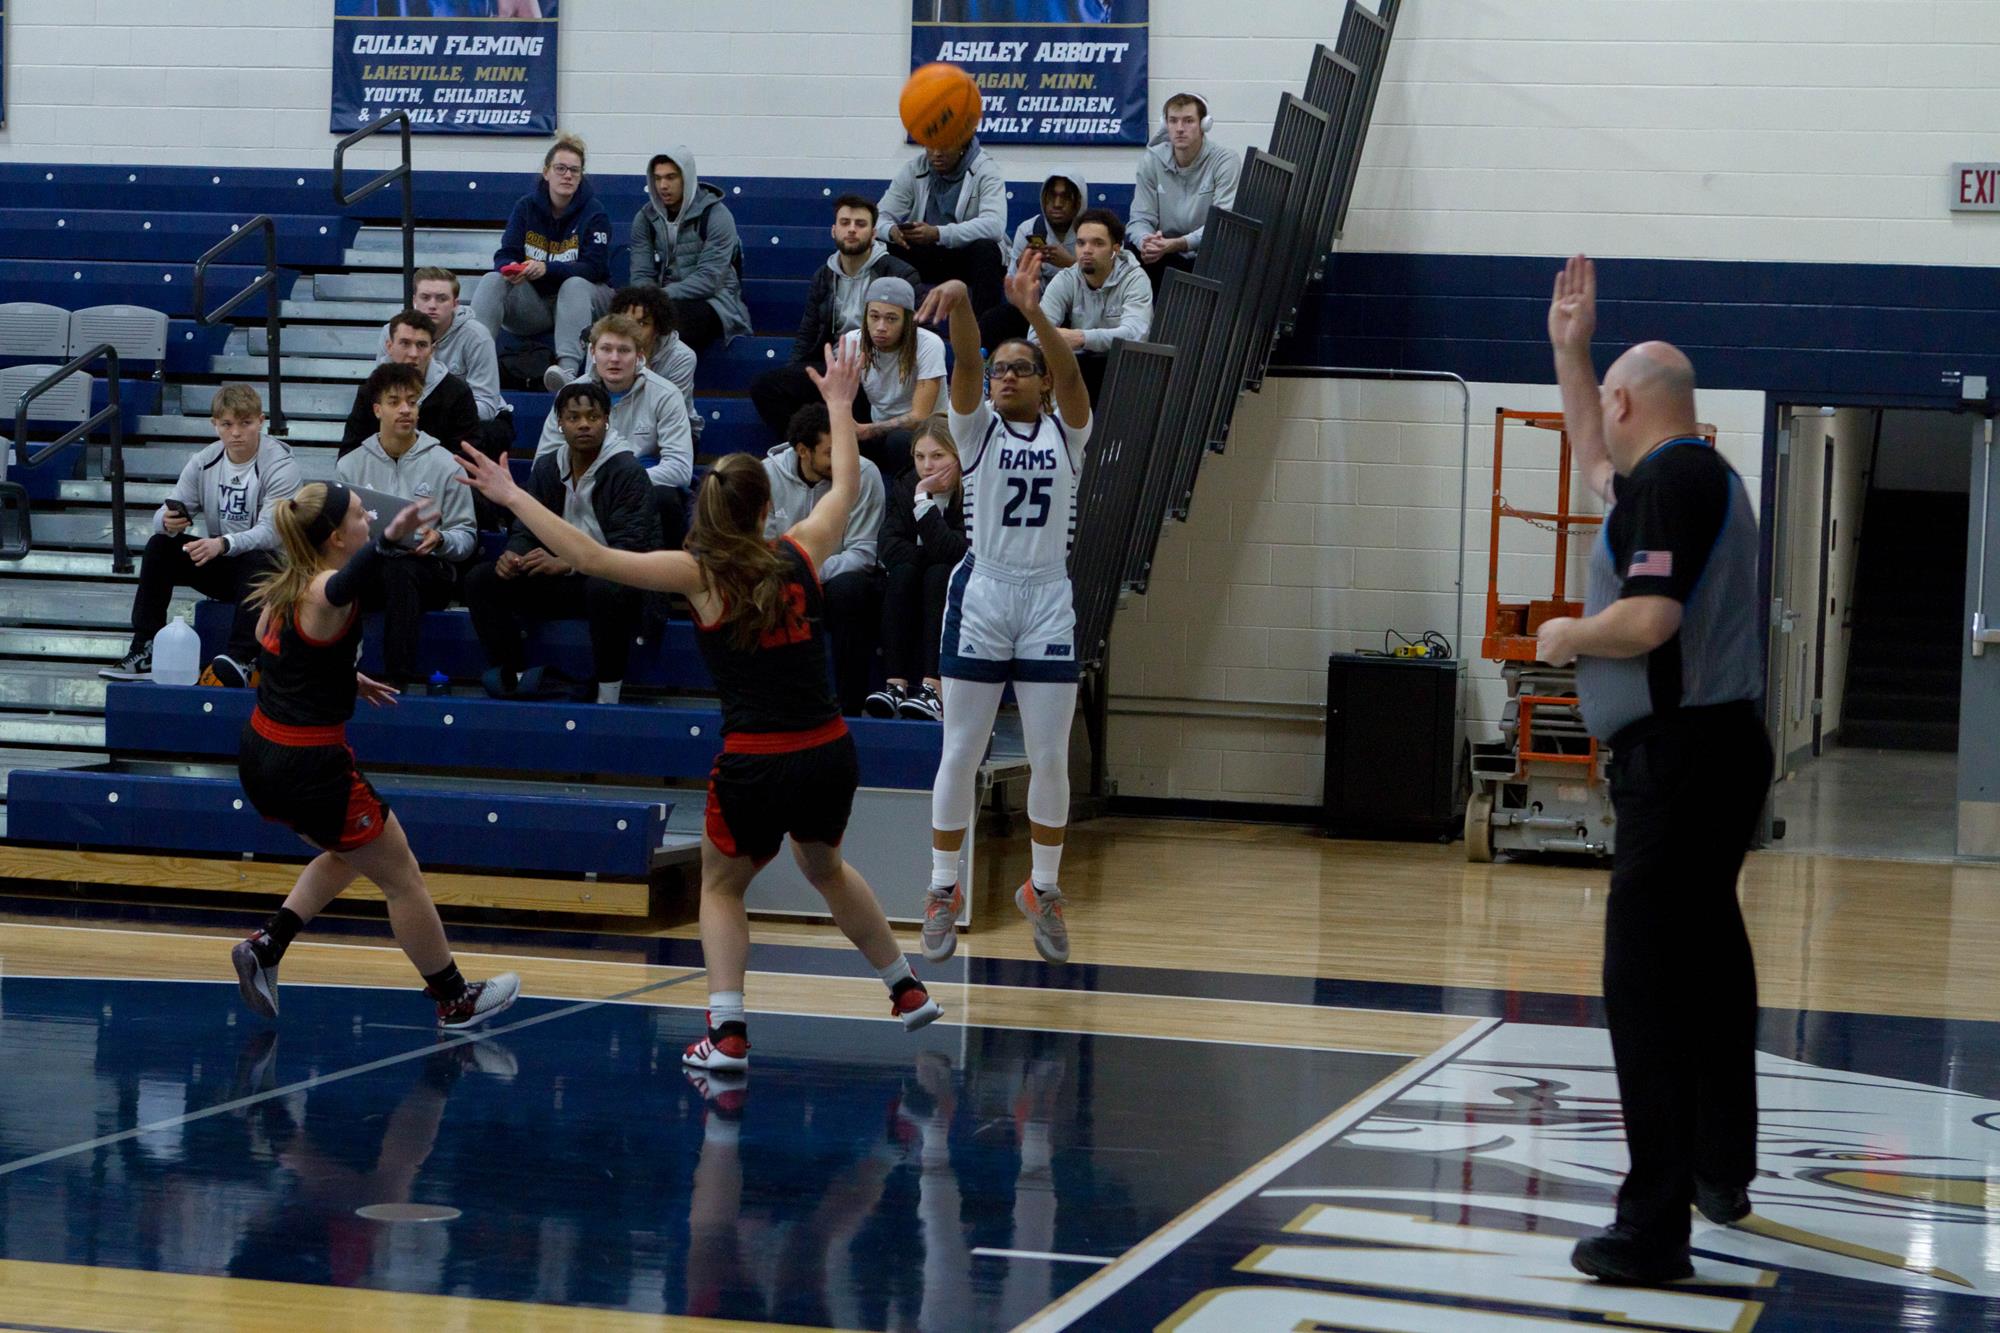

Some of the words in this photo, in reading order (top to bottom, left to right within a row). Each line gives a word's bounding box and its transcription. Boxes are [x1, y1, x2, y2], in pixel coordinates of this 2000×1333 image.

[353, 35, 438, 54] CULLEN
[443, 35, 544, 56] FLEMING
[936, 41, 1029, 62] ASHLEY
[1034, 42, 1129, 63] ABBOTT
[362, 65, 465, 83] LAKEVILLE,
[474, 66, 528, 82] MINN.
[968, 72, 1030, 90] AGAN,
[1040, 73, 1097, 89] MINN.
[364, 87, 424, 104] YOUTH,
[433, 88, 526, 105] CHILDREN,
[1017, 96, 1117, 114] CHILDREN,
[358, 108, 370, 122] &
[379, 108, 448, 123] FMILY
[454, 109, 531, 124] STUDIES
[1039, 118, 1121, 134] STUDIES
[1960, 169, 2000, 203] EXI
[999, 448, 1057, 470] RAMS
[1002, 477, 1053, 527] 25
